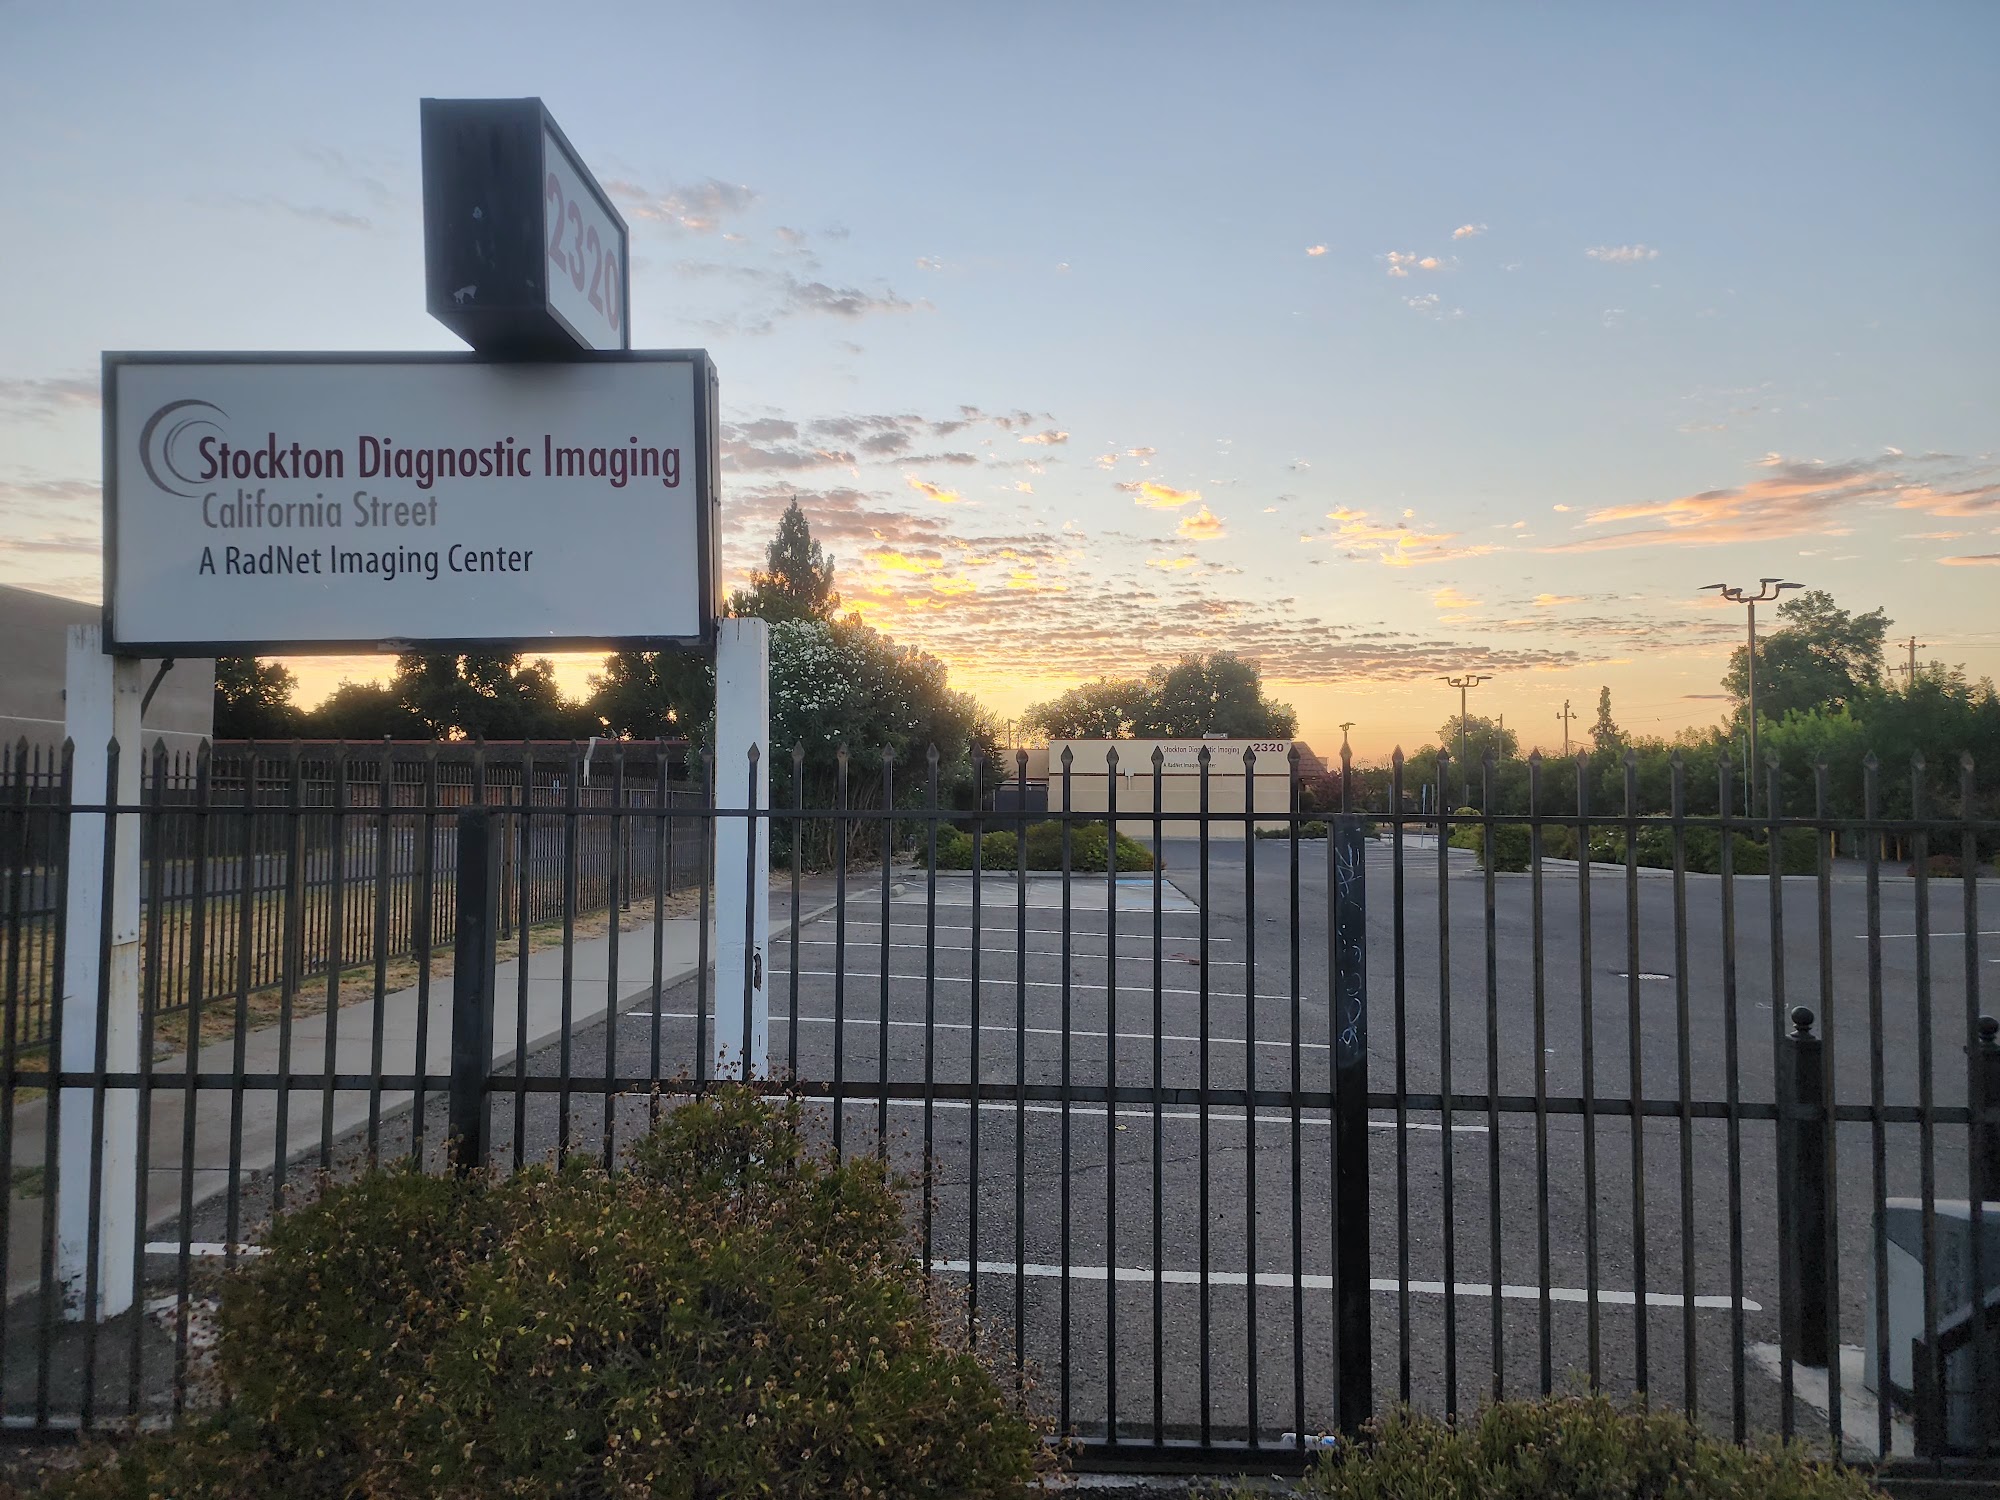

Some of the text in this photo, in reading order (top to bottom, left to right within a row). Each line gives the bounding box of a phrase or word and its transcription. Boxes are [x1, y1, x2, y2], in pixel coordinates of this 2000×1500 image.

[547, 172, 620, 332] 2320
[199, 432, 680, 490] Stockton Diagnostic Imaging
[202, 488, 438, 529] California Street
[199, 543, 533, 581] A RadNet Imaging Center
[1163, 745, 1187, 753] Stockton
[1253, 743, 1284, 752] 2320
